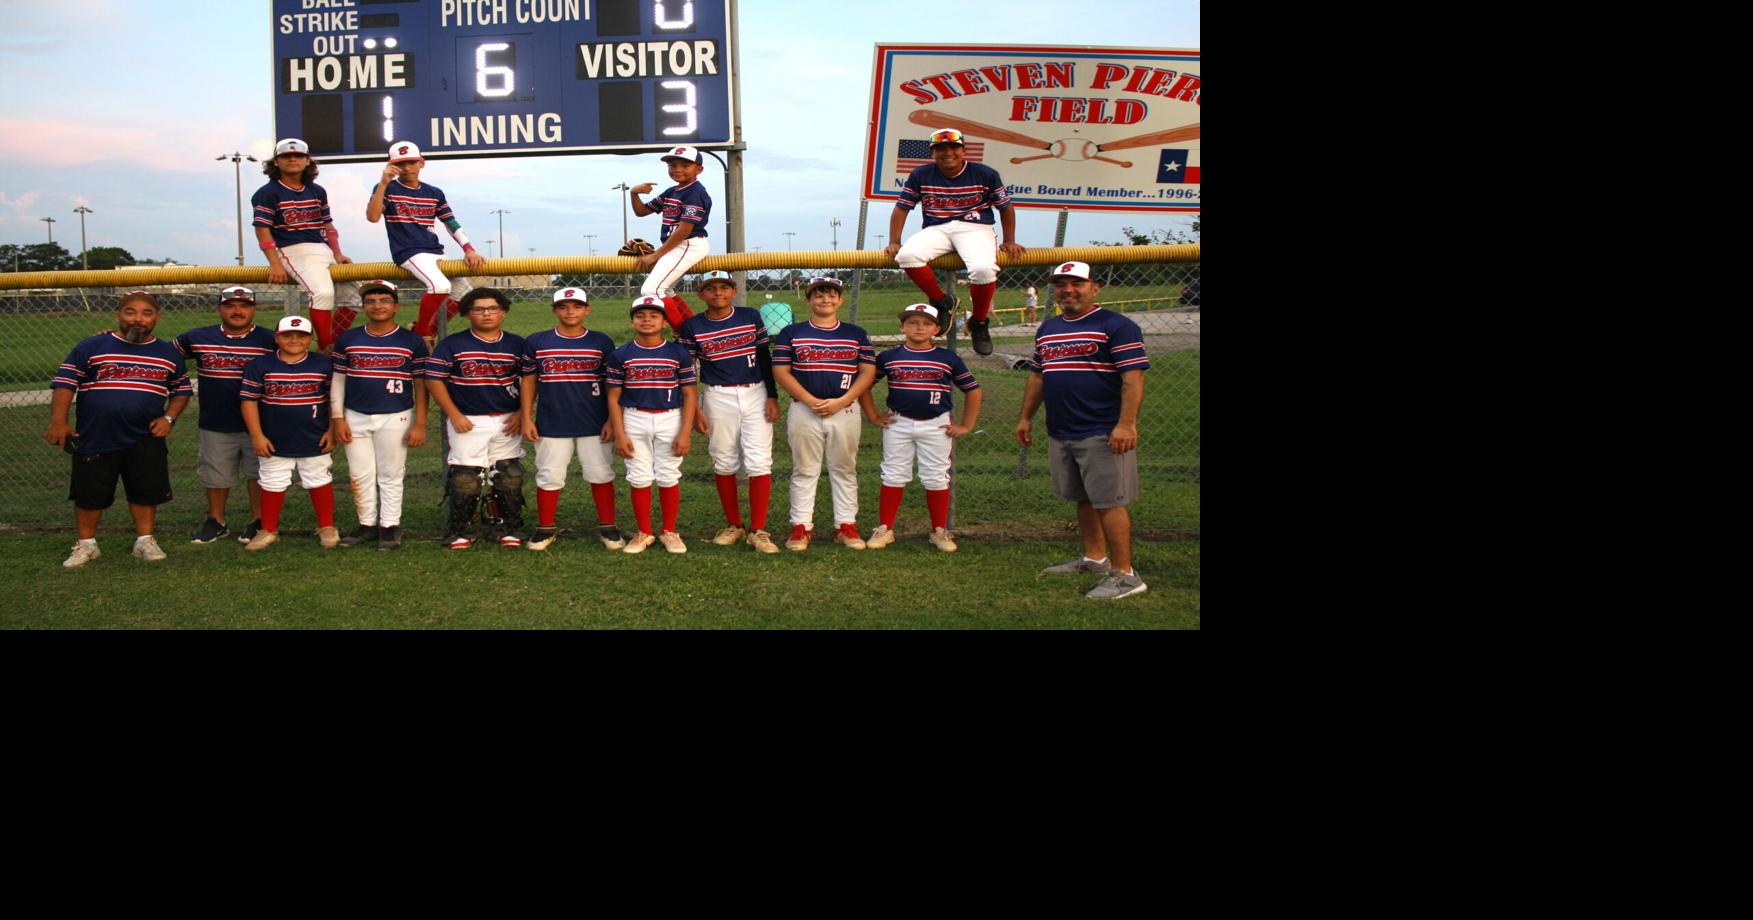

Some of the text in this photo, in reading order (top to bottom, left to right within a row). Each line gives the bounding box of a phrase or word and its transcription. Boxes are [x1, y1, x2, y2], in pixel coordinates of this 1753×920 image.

[280, 11, 359, 34] STRIKE
[441, 0, 591, 27] PITCH COUNT
[313, 35, 359, 56] OUT
[290, 53, 406, 92] HOME
[475, 43, 515, 97] 6
[580, 40, 718, 79] VISITOR
[900, 62, 1200, 106] STEVEN PIER
[383, 95, 394, 142] 1
[660, 80, 697, 136] 3
[1008, 96, 1148, 124] FIELD
[430, 112, 562, 147] INNING
[1005, 184, 1032, 195] gue
[1037, 184, 1082, 196] Board
[386, 379, 404, 394] 43
[592, 382, 600, 397] 3
[667, 389, 672, 402] 1
[839, 374, 852, 390] 21
[929, 391, 941, 405] 12
